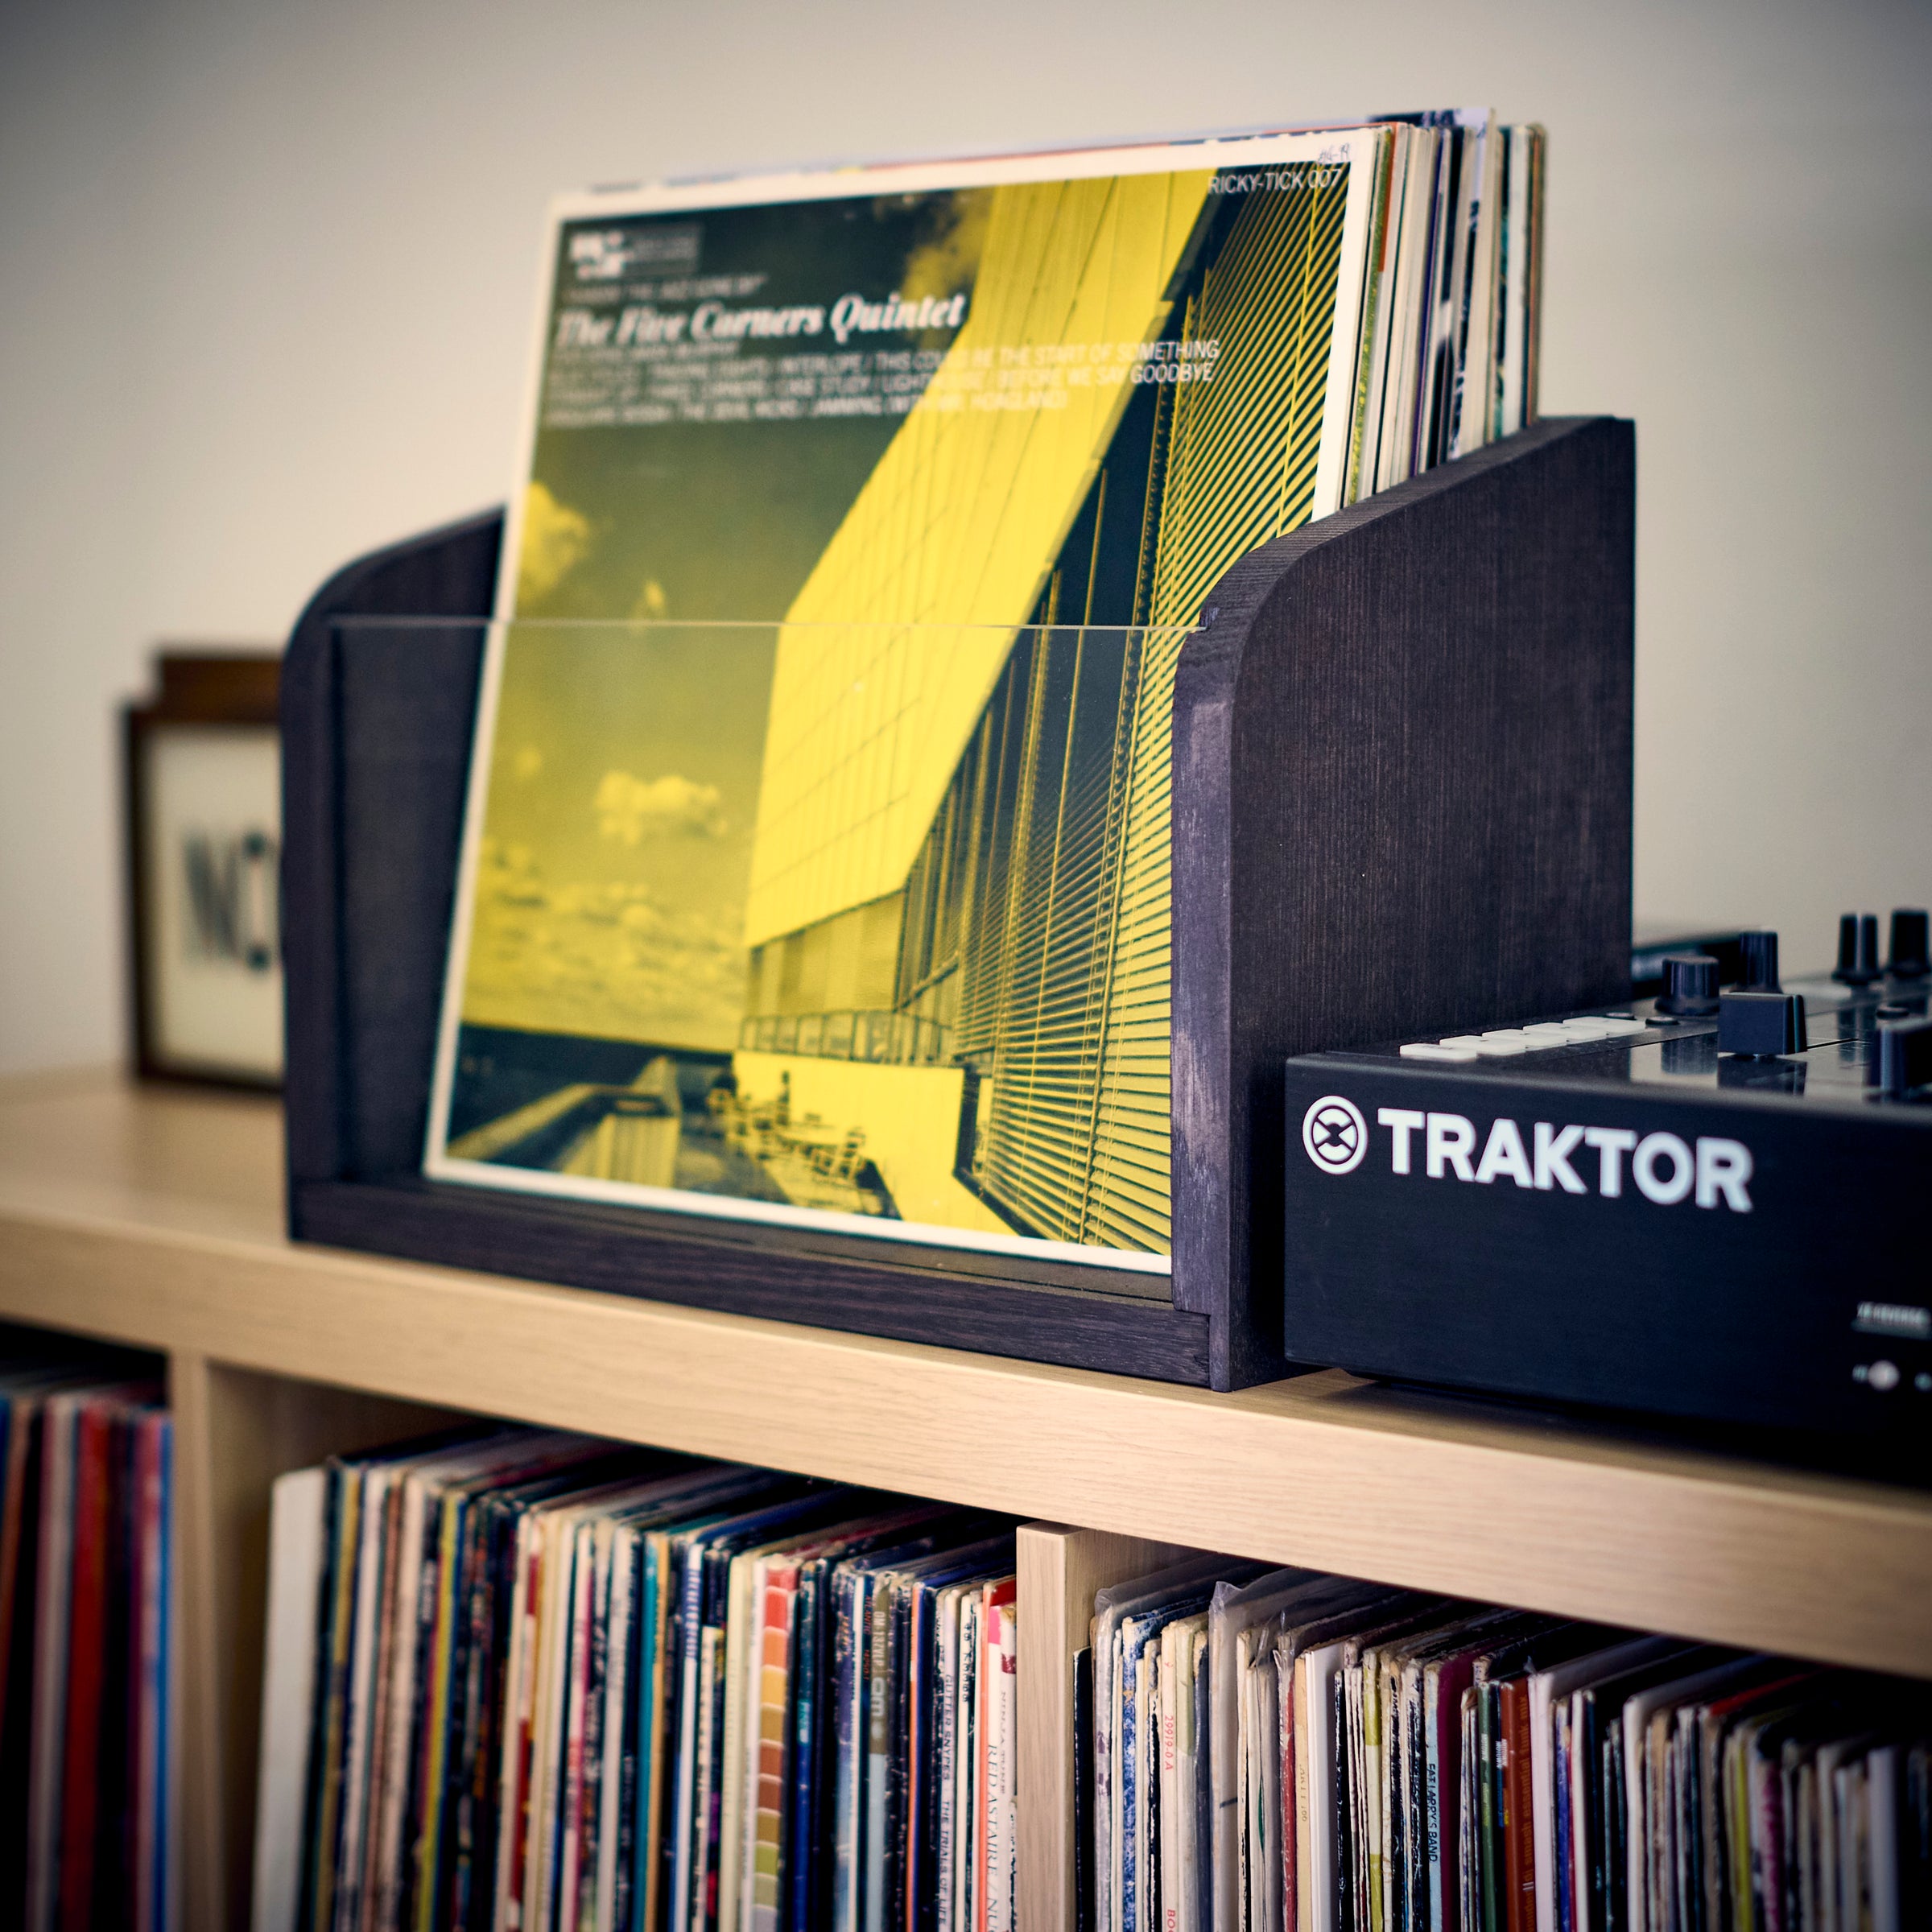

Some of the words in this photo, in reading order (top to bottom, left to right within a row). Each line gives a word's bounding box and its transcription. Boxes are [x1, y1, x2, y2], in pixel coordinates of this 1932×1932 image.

[1208, 171, 1303, 193] RICKY-TICK
[1307, 168, 1342, 188] 007
[691, 299, 824, 341] Corners
[829, 290, 966, 344] Quintet
[1089, 343, 1114, 363] OF
[1117, 340, 1220, 361] SOMETHING
[1096, 365, 1127, 386] SAY
[1129, 362, 1214, 384] GOODBYE
[1376, 1106, 1755, 1213] TRAKTOR
[944, 1674, 953, 1726] GUTTER
[1518, 1695, 1529, 1719] mix
[1164, 1715, 1174, 1758] 29919-0
[1519, 1725, 1530, 1755] funk
[943, 1731, 952, 1781] SNYPES
[988, 1744, 998, 1788] RED
[1164, 1761, 1174, 1770] A
[1427, 1764, 1436, 1783] FAT
[1520, 1757, 1532, 1818] essential
[940, 1801, 950, 1824] THE
[1427, 1785, 1437, 1828] LARRY'S
[987, 1792, 998, 1876] ASTAIRE
[1429, 1831, 1438, 1862] BAND
[1521, 1822, 1533, 1866] smash
[939, 1831, 950, 1874] TRIALS
[938, 1899, 948, 1926] LIFE
[987, 1897, 998, 1932] NU
[1166, 1909, 1176, 1932] BO
